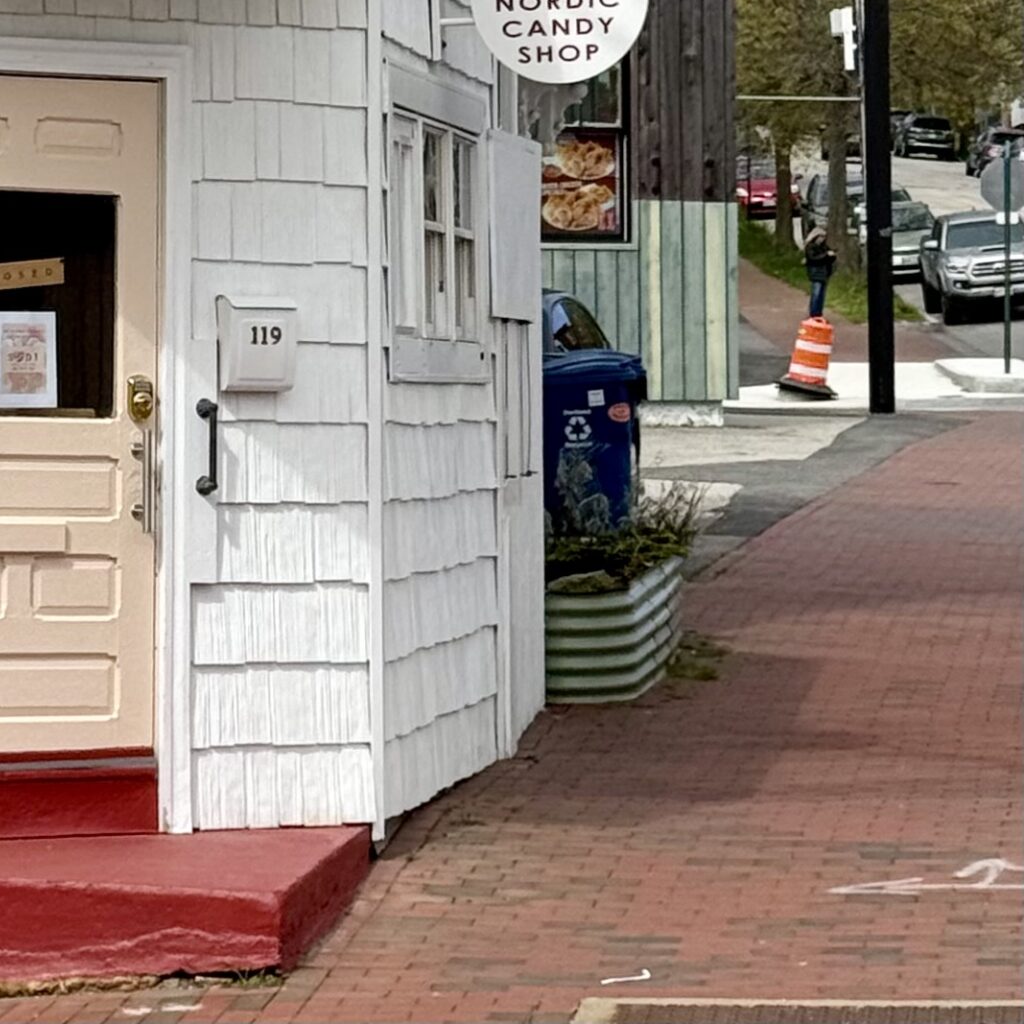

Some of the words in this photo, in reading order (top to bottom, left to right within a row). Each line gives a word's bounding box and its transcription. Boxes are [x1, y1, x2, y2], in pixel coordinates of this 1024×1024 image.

[502, 17, 614, 38] CANDY
[518, 44, 599, 64] SHOP
[250, 326, 282, 345] 119
